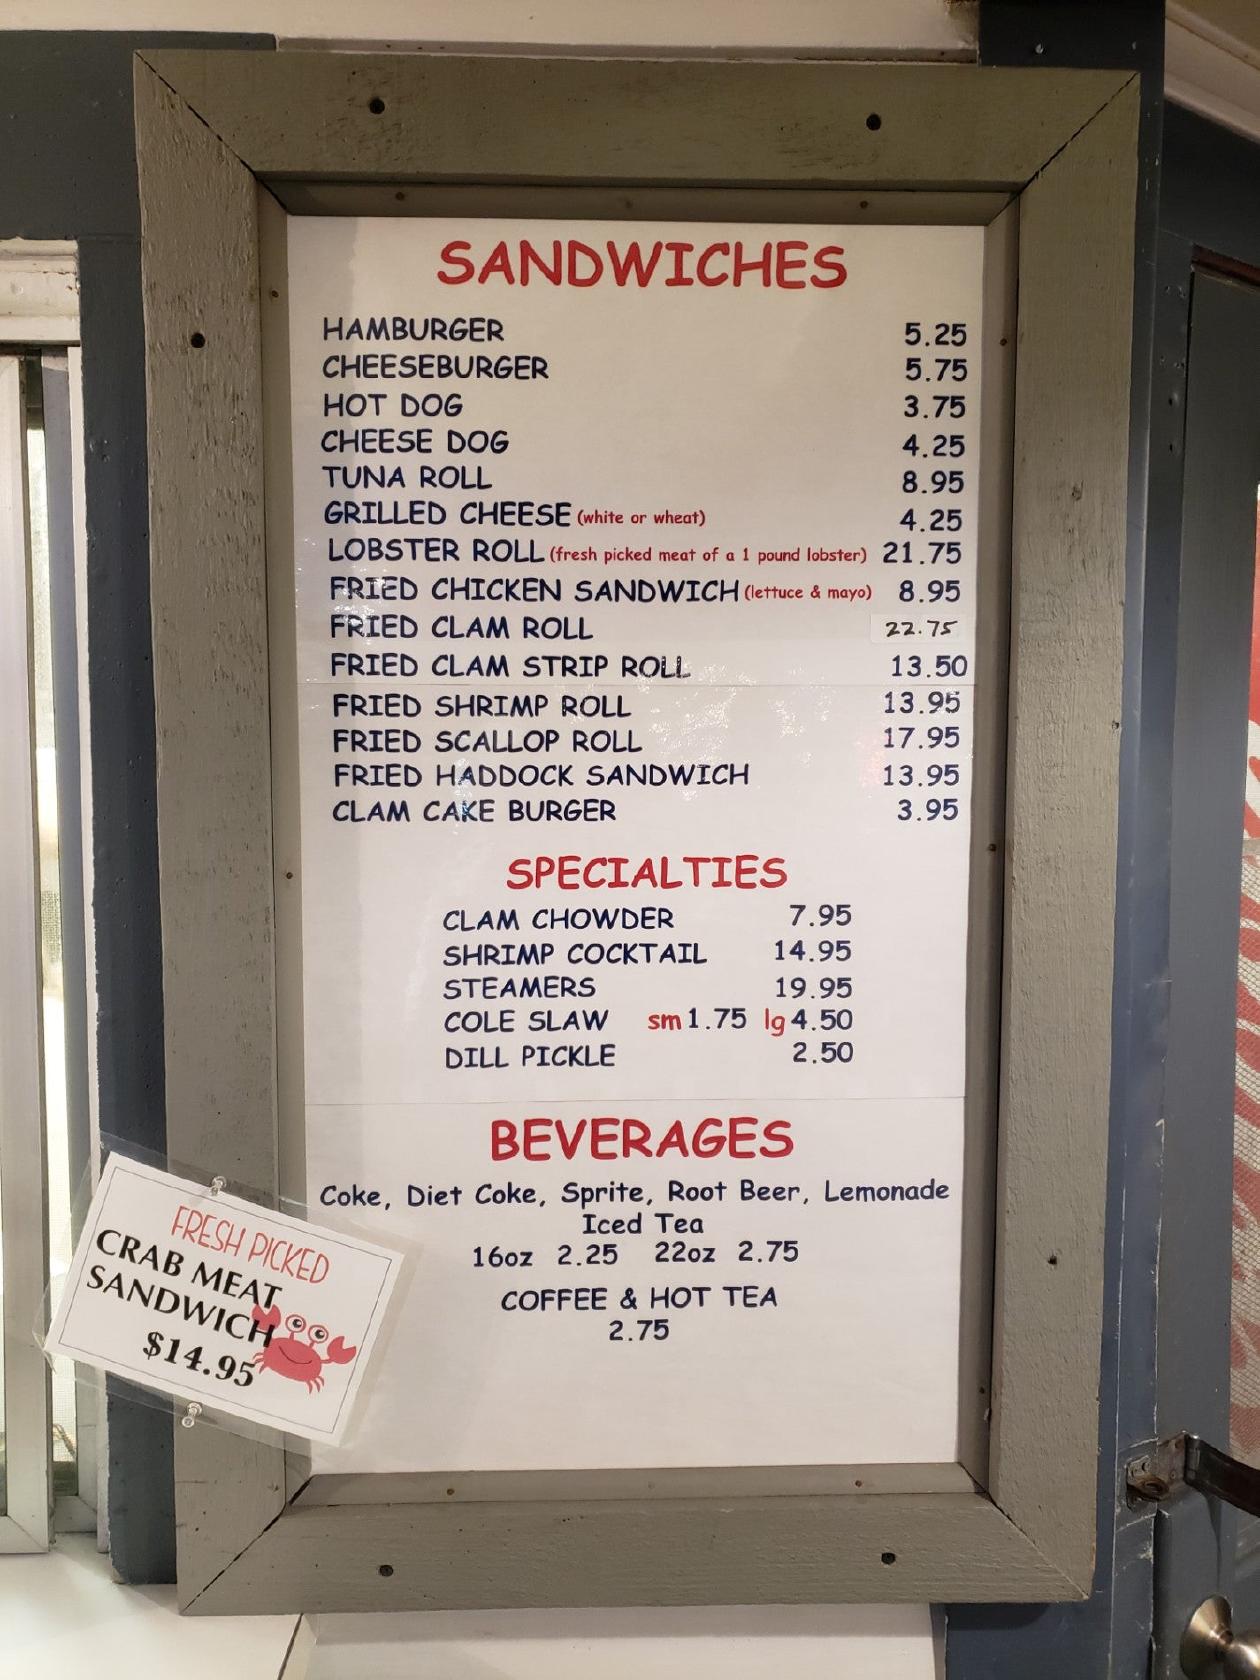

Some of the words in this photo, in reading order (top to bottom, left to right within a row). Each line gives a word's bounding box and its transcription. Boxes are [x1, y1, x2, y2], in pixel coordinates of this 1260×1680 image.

[436, 239, 848, 290] SANDWICHES
[323, 316, 505, 343] HAMBURGER
[904, 321, 967, 348] 5.25
[322, 353, 550, 381] CHEESEBURGER
[905, 356, 968, 383] 5.75
[323, 392, 388, 418] HOT
[400, 392, 464, 418] DOG
[903, 394, 966, 419] 3.75
[320, 427, 433, 454] CHEESE
[447, 428, 510, 455] DOG
[901, 433, 966, 459] 4.25
[321, 464, 407, 490] TUNA
[419, 464, 493, 491] ROLL
[901, 469, 965, 495] 8.95
[323, 499, 447, 526] GRILLED
[459, 500, 573, 528] CHEESE
[576, 508, 624, 527] (white
[630, 513, 648, 525] or
[653, 508, 706, 528] wheat)
[898, 507, 963, 533] 4.25
[328, 537, 461, 563] LOBSTER
[472, 537, 546, 564] ROLL
[549, 545, 598, 564] (fresh
[603, 546, 652, 566] picked
[658, 548, 697, 563] meat
[702, 546, 720, 563] of
[725, 551, 736, 562] a
[742, 547, 750, 562] 1
[757, 546, 801, 566] pound
[806, 546, 867, 565] lobster)
[882, 540, 962, 565] 21.75
[330, 575, 419, 601] FRIED
[431, 576, 562, 603] CHICKEN
[573, 578, 740, 604] SANDWICH
[744, 584, 804, 602] (lettuce
[809, 584, 821, 600] &
[827, 583, 873, 603] mayo)
[898, 579, 961, 604] 8.95
[330, 613, 419, 639] FRIED
[431, 614, 511, 640] CLAM
[522, 615, 594, 641] ROLL
[885, 619, 959, 638] 22.75
[330, 652, 419, 678] FRIED
[431, 653, 510, 678] CLAM
[522, 654, 609, 678] STRIP
[621, 655, 692, 680] ROLL
[891, 654, 968, 679] 13.50
[332, 692, 422, 719] FRIED
[434, 693, 549, 719] SHRIMP
[561, 694, 633, 719] ROLL
[884, 690, 961, 715] 13.95
[332, 728, 422, 754] FRIED
[434, 728, 561, 754] SCALLOP
[572, 729, 644, 754] ROLL
[883, 726, 960, 750] 17.95
[334, 762, 423, 788] FRIED
[436, 763, 575, 788] HADDOCK
[585, 762, 750, 787] SANDWICH
[883, 763, 960, 788] 13.95
[332, 799, 411, 823] CLAM
[422, 798, 496, 824] CAKE
[508, 797, 617, 823] BURGER
[897, 797, 959, 822] 3.95
[506, 853, 788, 891] SPECIALTIES
[442, 908, 521, 933] CLAM
[531, 905, 675, 930] CHOWDER
[789, 903, 852, 927] 7.95
[442, 942, 555, 967] SHRIMP
[567, 942, 708, 966] COCKTAIL
[774, 939, 852, 963] 14.95
[442, 974, 597, 1001] STEAMERS
[775, 976, 853, 1000] 19.95
[443, 1008, 516, 1034] COLE
[527, 1008, 610, 1033] SLAW
[647, 1013, 683, 1032] sm
[688, 1006, 748, 1031] 1.75
[764, 1007, 786, 1038] lg
[790, 1008, 854, 1032] 4.50
[445, 1045, 510, 1070] DILL
[521, 1043, 617, 1068] PICKLE
[792, 1041, 854, 1065] 2.50
[490, 1116, 795, 1162] BEVERAGES
[319, 1183, 391, 1211] Coke,
[407, 1183, 463, 1208] Diet
[474, 1180, 546, 1208] Coke,
[560, 1180, 653, 1211] Sprite,
[668, 1179, 728, 1202] Root
[740, 1178, 809, 1206] Beer,
[824, 1177, 950, 1203] Lemonade
[581, 1211, 643, 1235] Iced
[653, 1212, 705, 1234] Tea
[171, 1205, 247, 1256] FRESH
[248, 1231, 330, 1284] PICKED
[472, 1245, 534, 1269] 16oz
[557, 1243, 619, 1267] 2.25
[654, 1240, 717, 1264] 22oz
[737, 1239, 799, 1264] 2.75
[96, 1228, 185, 1277] CRAB
[191, 1261, 282, 1309] MEAT
[86, 1265, 275, 1348] SANDWICH
[500, 1286, 608, 1312] COFFEE
[619, 1286, 638, 1311] &
[650, 1286, 712, 1310] HOT
[721, 1284, 778, 1309] TEA
[608, 1318, 670, 1342] 2.75
[142, 1332, 255, 1388] $14.95
